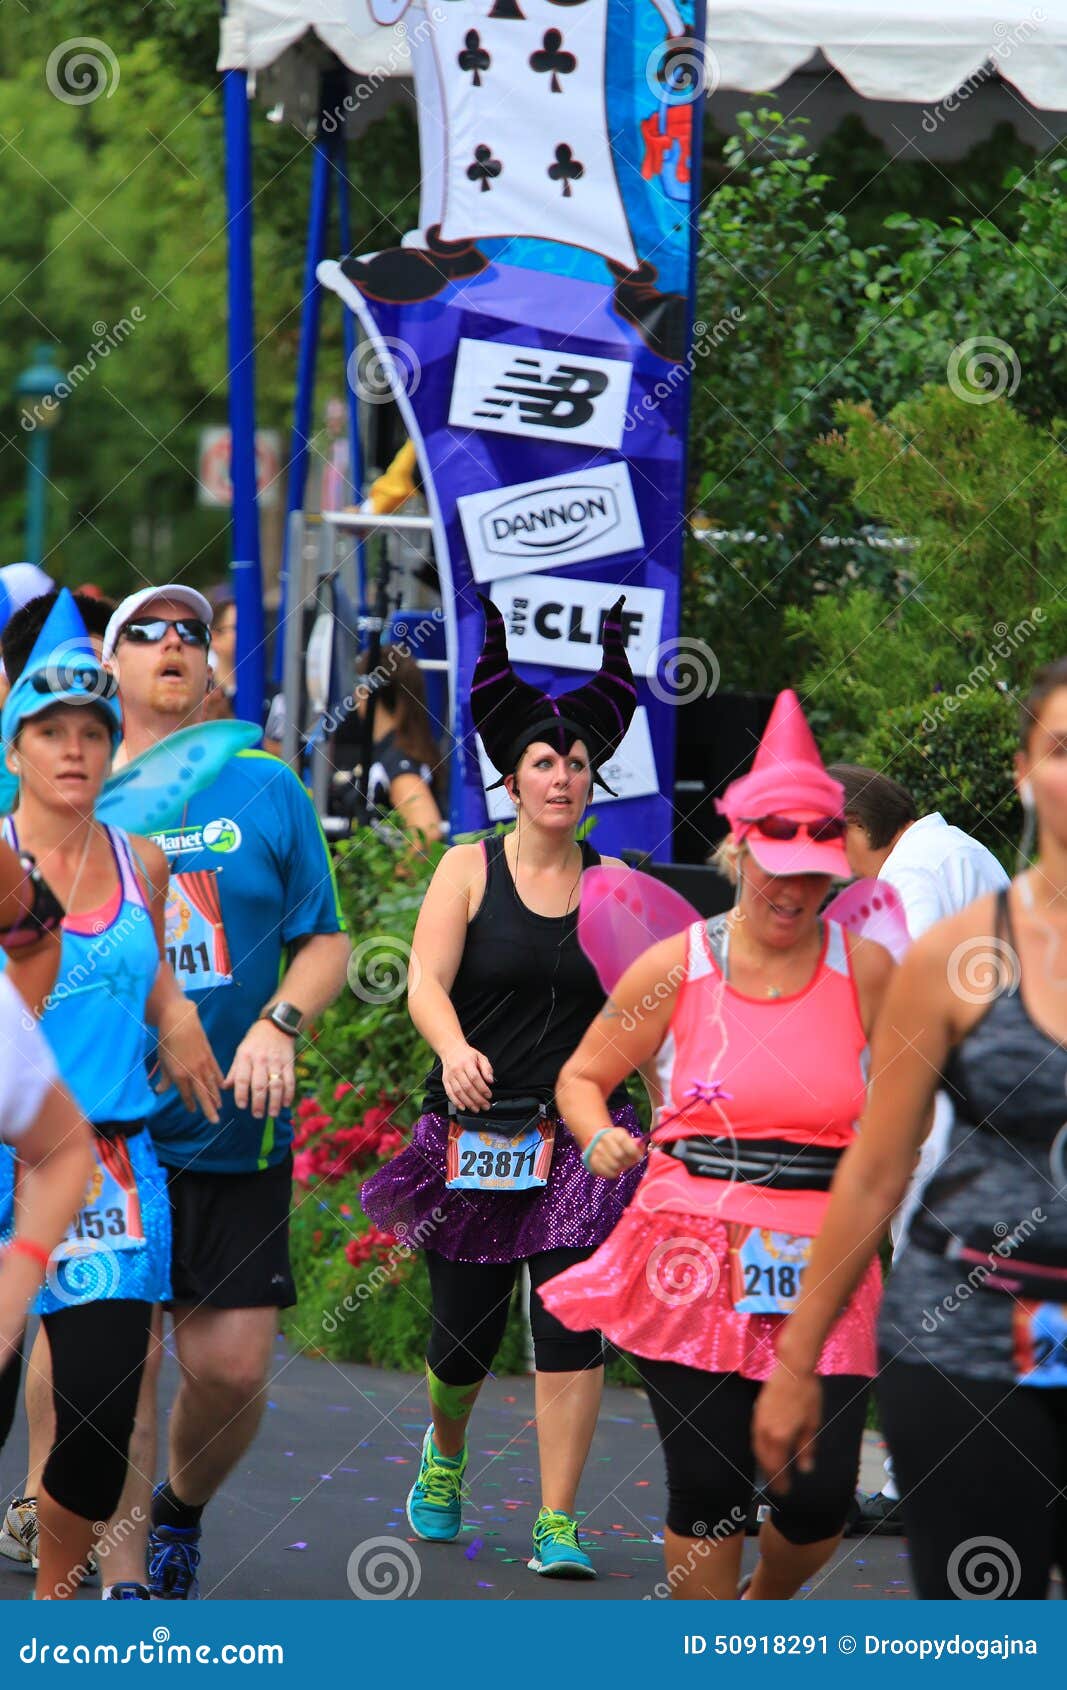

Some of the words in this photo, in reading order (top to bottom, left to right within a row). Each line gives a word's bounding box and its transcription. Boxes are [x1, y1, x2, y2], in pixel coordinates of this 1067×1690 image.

[492, 496, 607, 539] DANNON
[510, 598, 529, 636] BAR
[460, 1150, 536, 1177] 23871
[744, 1264, 805, 1297] 218
